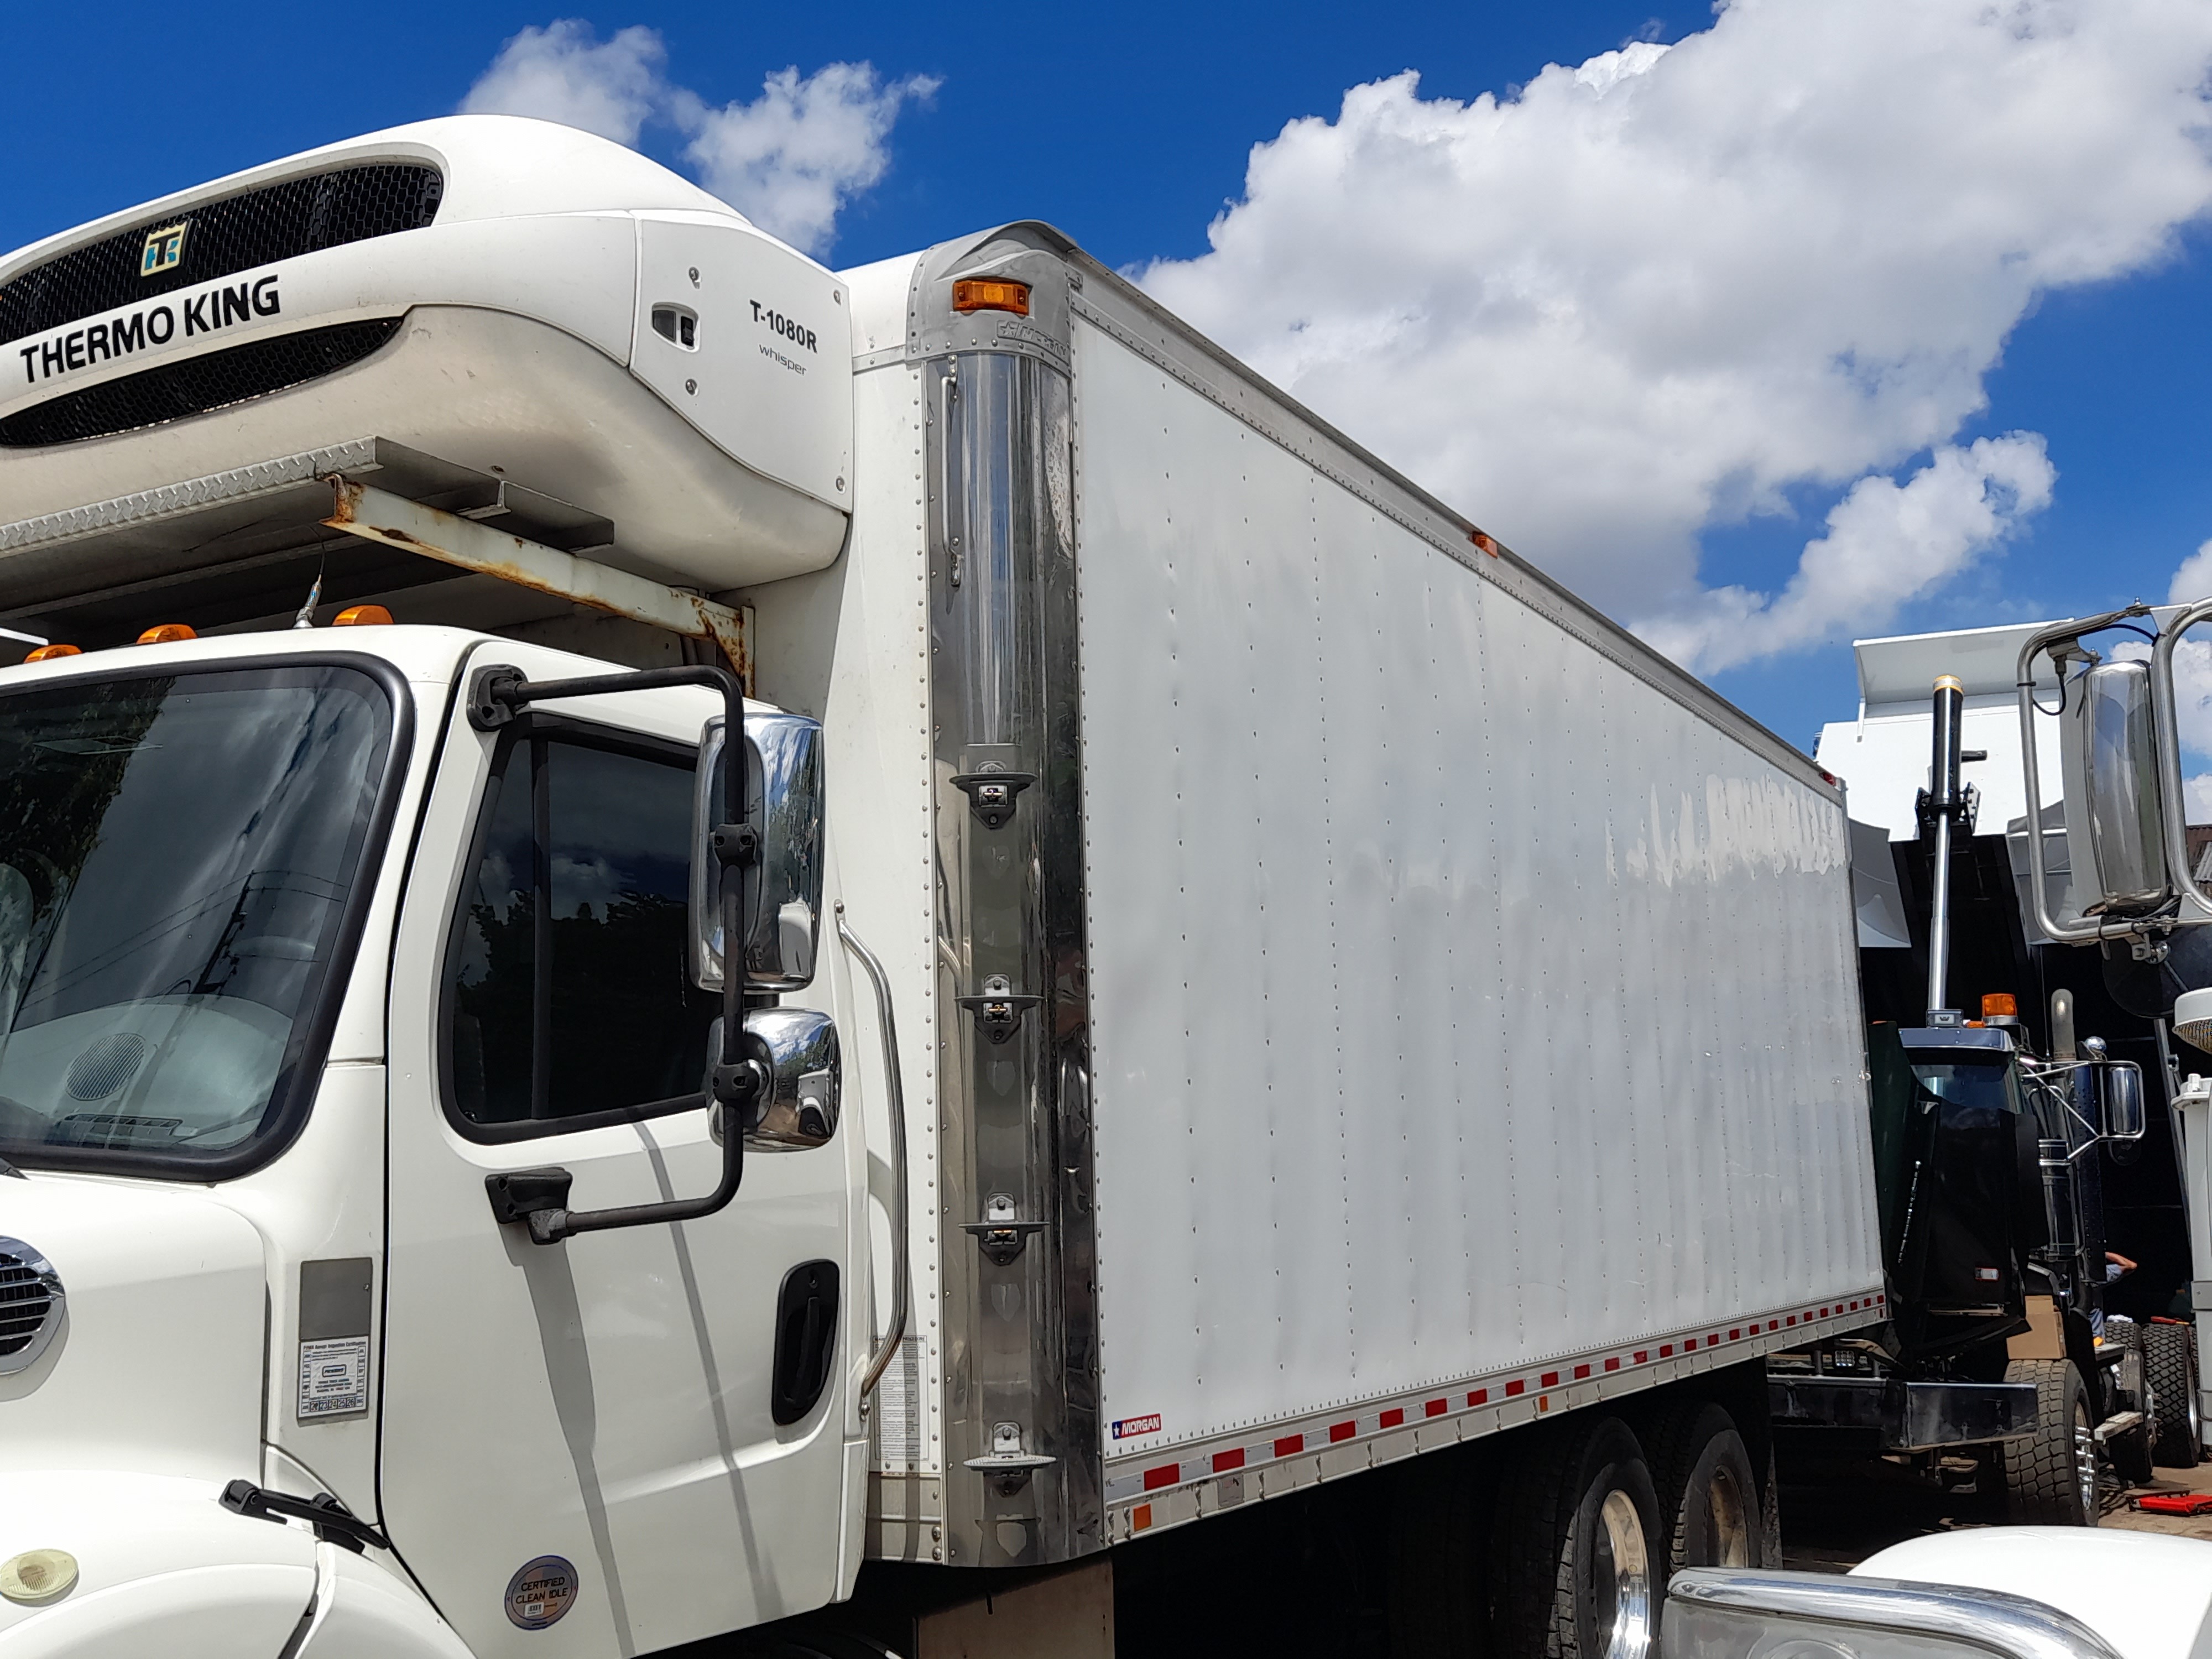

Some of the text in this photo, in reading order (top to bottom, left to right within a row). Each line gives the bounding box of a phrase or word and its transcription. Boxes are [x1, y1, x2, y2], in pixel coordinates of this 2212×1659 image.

[20, 274, 280, 384] THERMO KING
[749, 299, 818, 353] T-1080R
[759, 344, 807, 376] whisper
[1121, 1416, 1159, 1435] MORGAN
[515, 1588, 568, 1604] CLEAN IDLE
[521, 1577, 565, 1591] CERTIFIED
